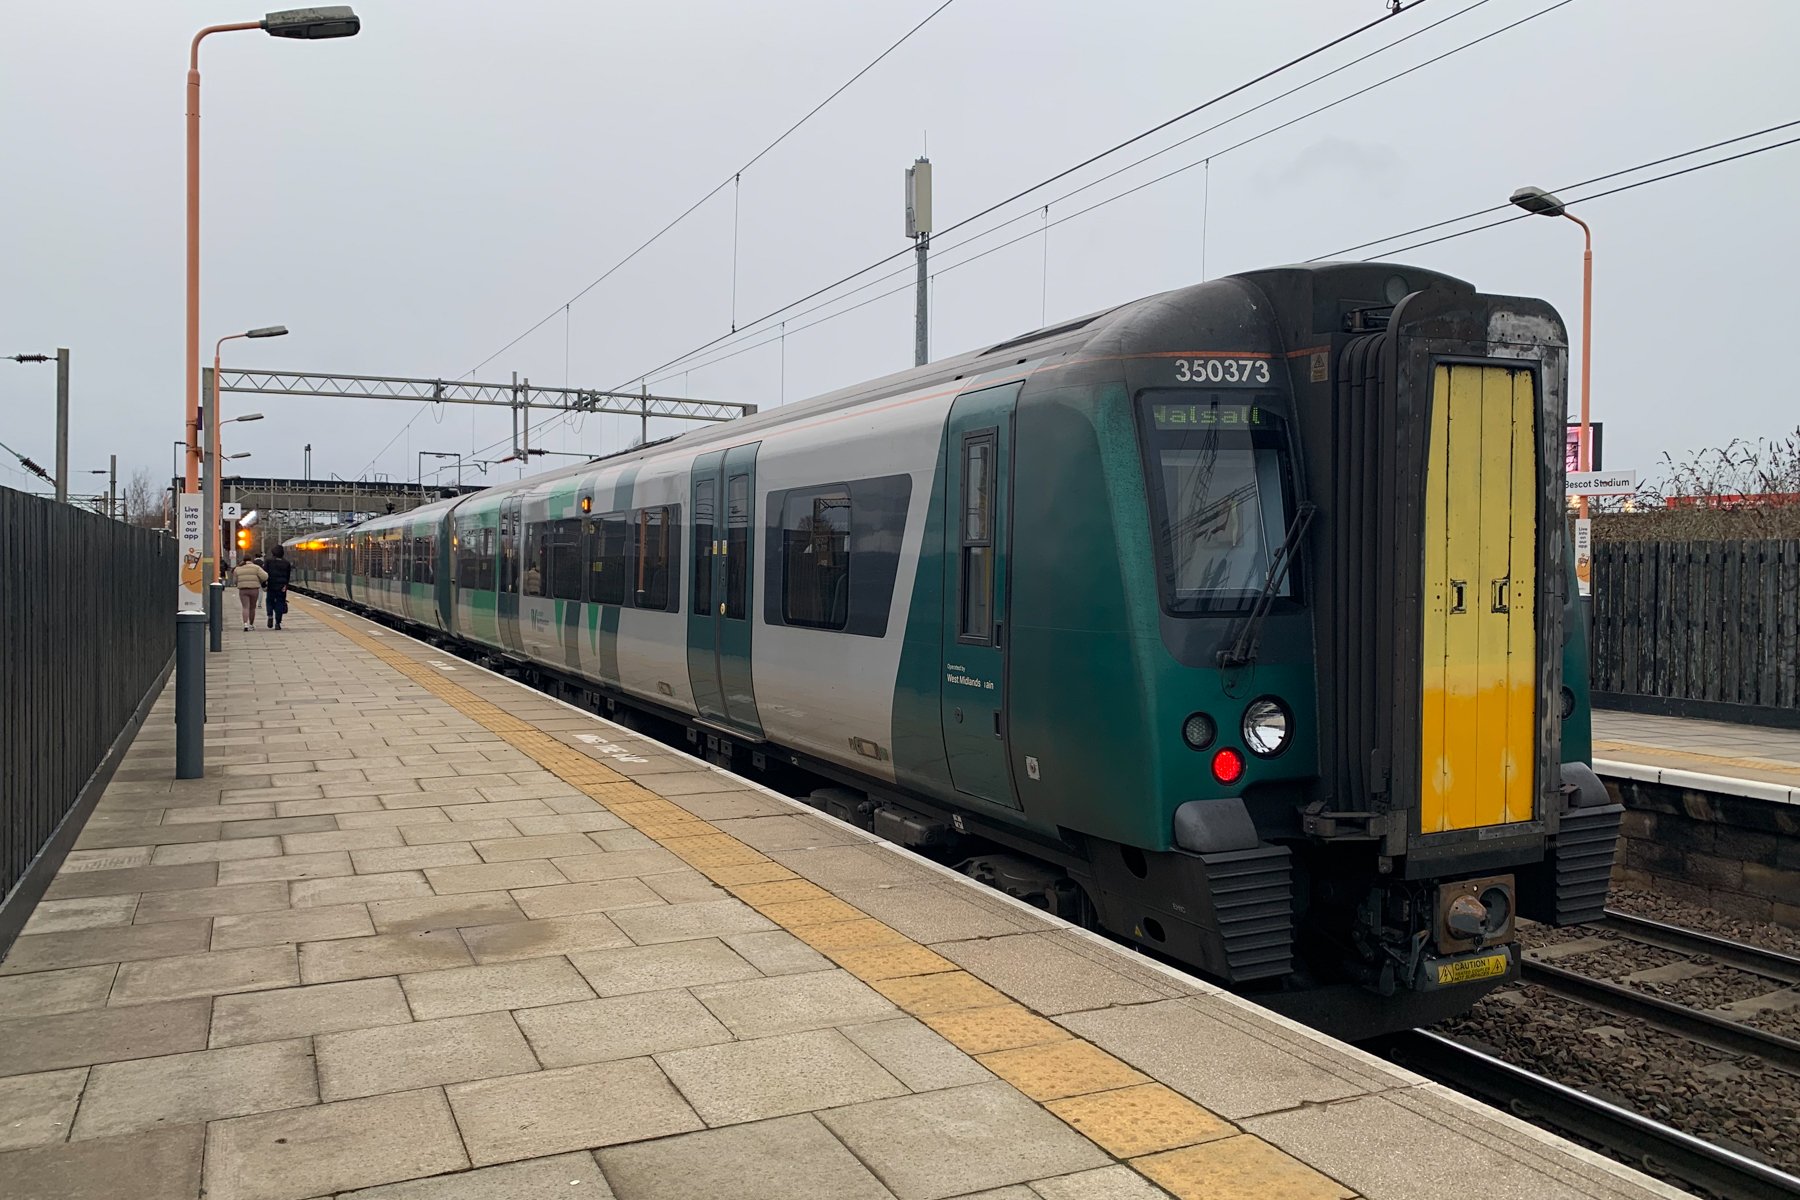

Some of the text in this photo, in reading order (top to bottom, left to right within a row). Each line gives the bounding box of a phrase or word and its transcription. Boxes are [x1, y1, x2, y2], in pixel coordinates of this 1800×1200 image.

[1175, 359, 1271, 383] 350373
[1565, 477, 1630, 489] Bescot Stadium
[228, 506, 235, 515] 2
[946, 673, 959, 684] West
[959, 675, 981, 688] Midlands
[1454, 959, 1486, 970] CAUTION
